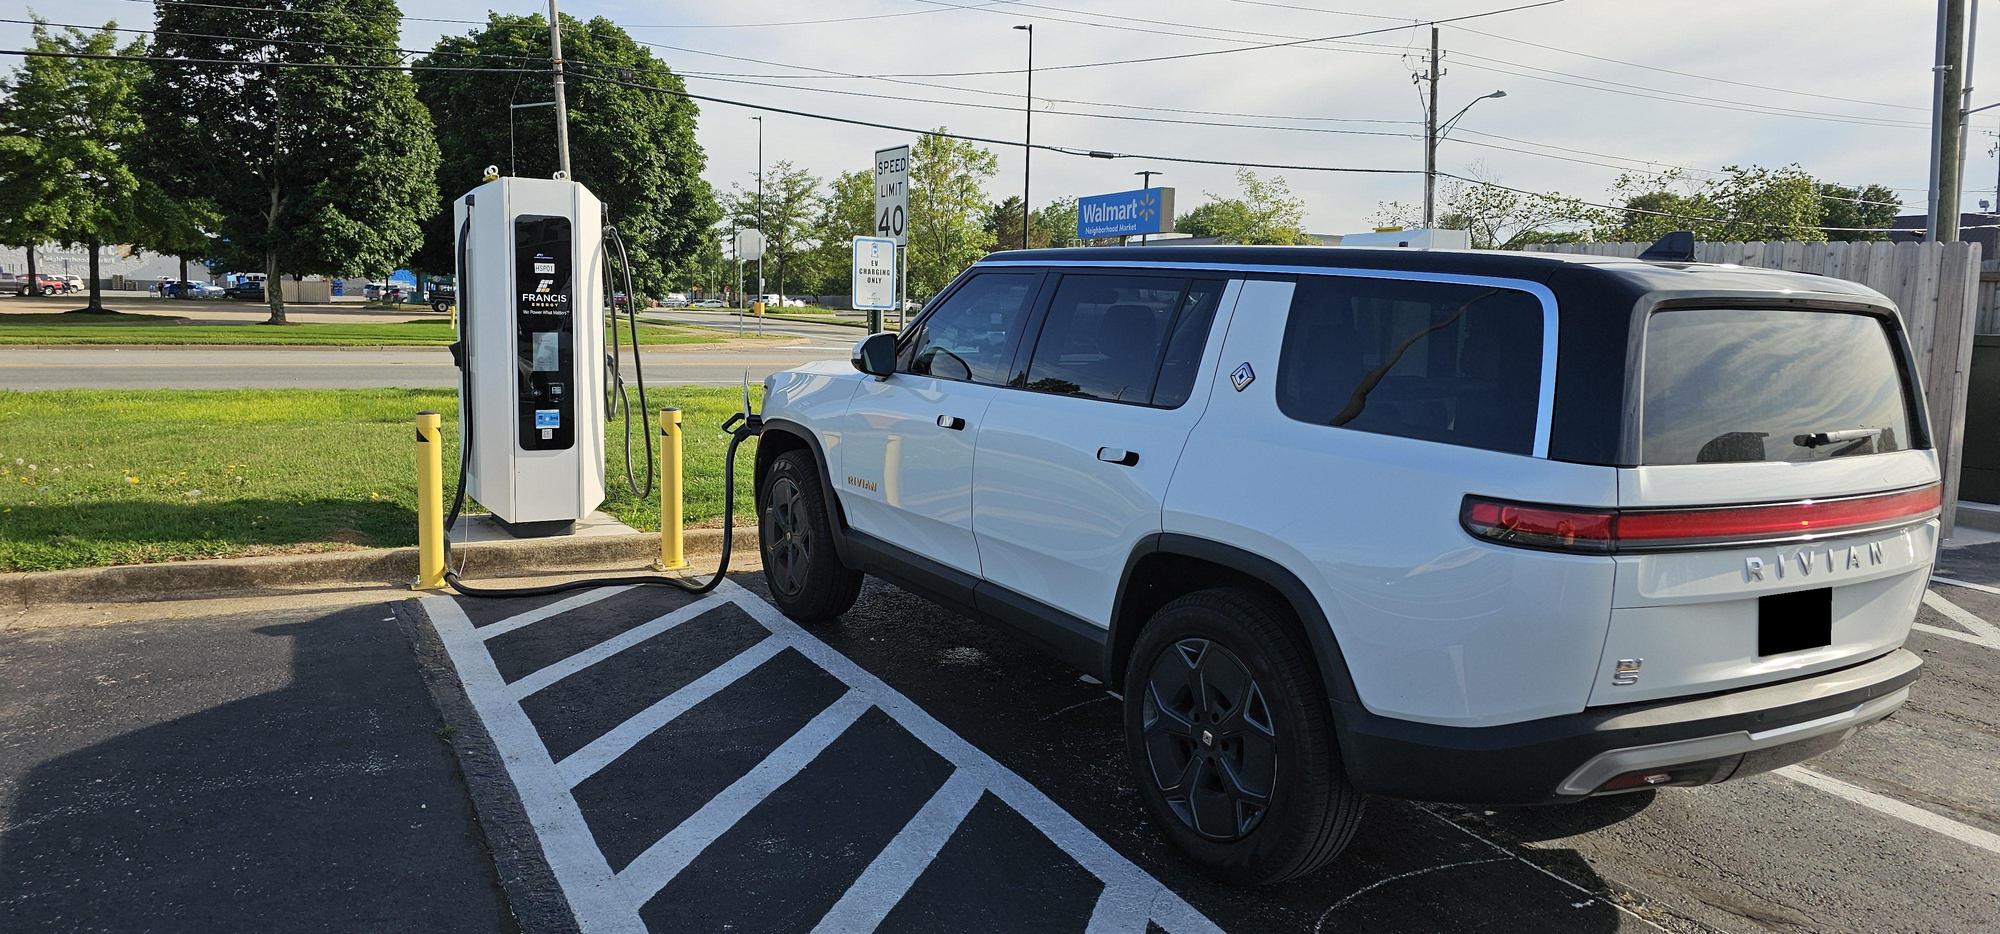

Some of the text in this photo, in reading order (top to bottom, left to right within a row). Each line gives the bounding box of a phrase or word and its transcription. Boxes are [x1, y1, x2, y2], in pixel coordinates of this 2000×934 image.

[878, 158, 906, 176] SPEED
[881, 182, 903, 198] LIMIT
[1083, 198, 1138, 224] Walmart
[878, 205, 904, 238] 40
[1085, 223, 1137, 236] Neighborhood Market
[859, 268, 891, 276] CHARGING
[522, 293, 567, 303] FRANCIS
[848, 475, 876, 492] RIVIAN
[1744, 541, 1884, 583] RIVIAN
